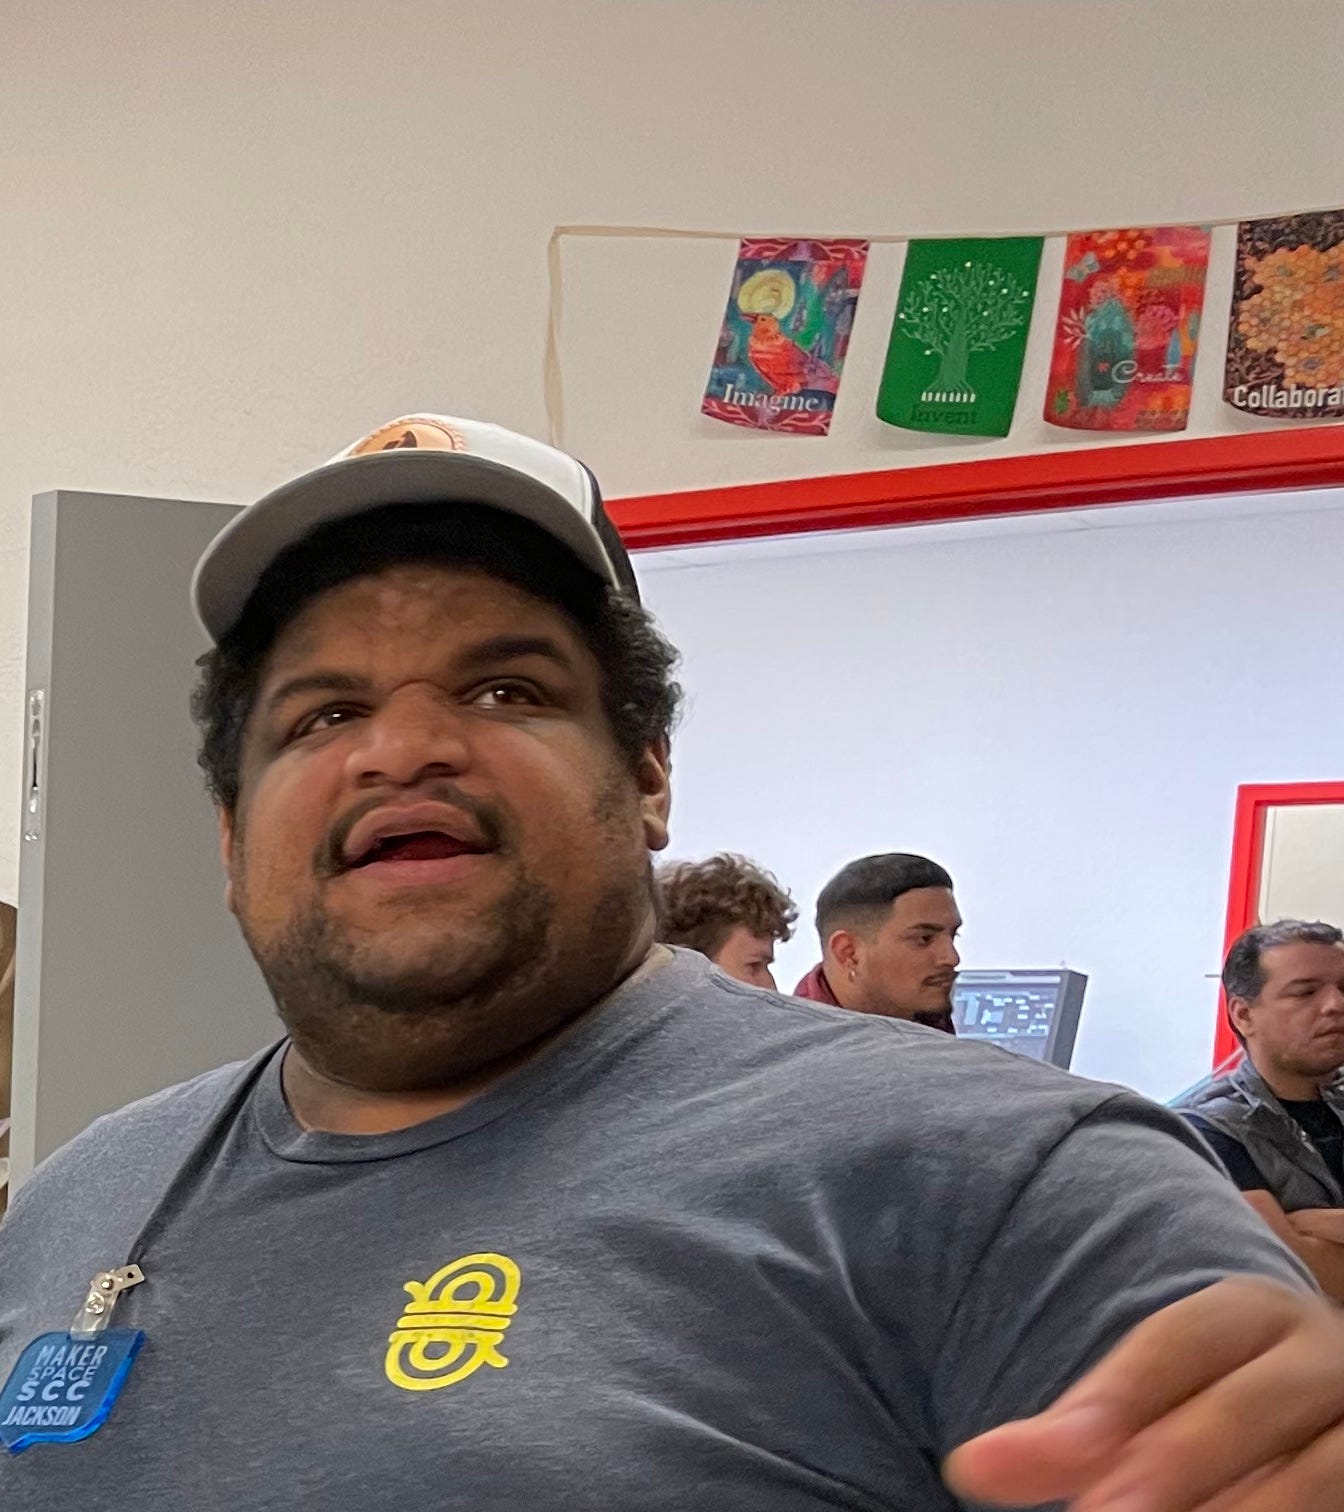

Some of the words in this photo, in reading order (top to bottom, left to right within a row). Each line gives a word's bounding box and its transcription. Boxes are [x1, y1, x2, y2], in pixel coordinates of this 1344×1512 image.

[1111, 360, 1183, 384] Create
[723, 383, 819, 413] Imagine
[1233, 384, 1344, 408] Collabora
[911, 404, 978, 424] Invent
[34, 1344, 108, 1367] MAKER
[26, 1366, 98, 1381] SPACE
[16, 1380, 91, 1402] SCC
[1, 1405, 82, 1426] JACKSON
